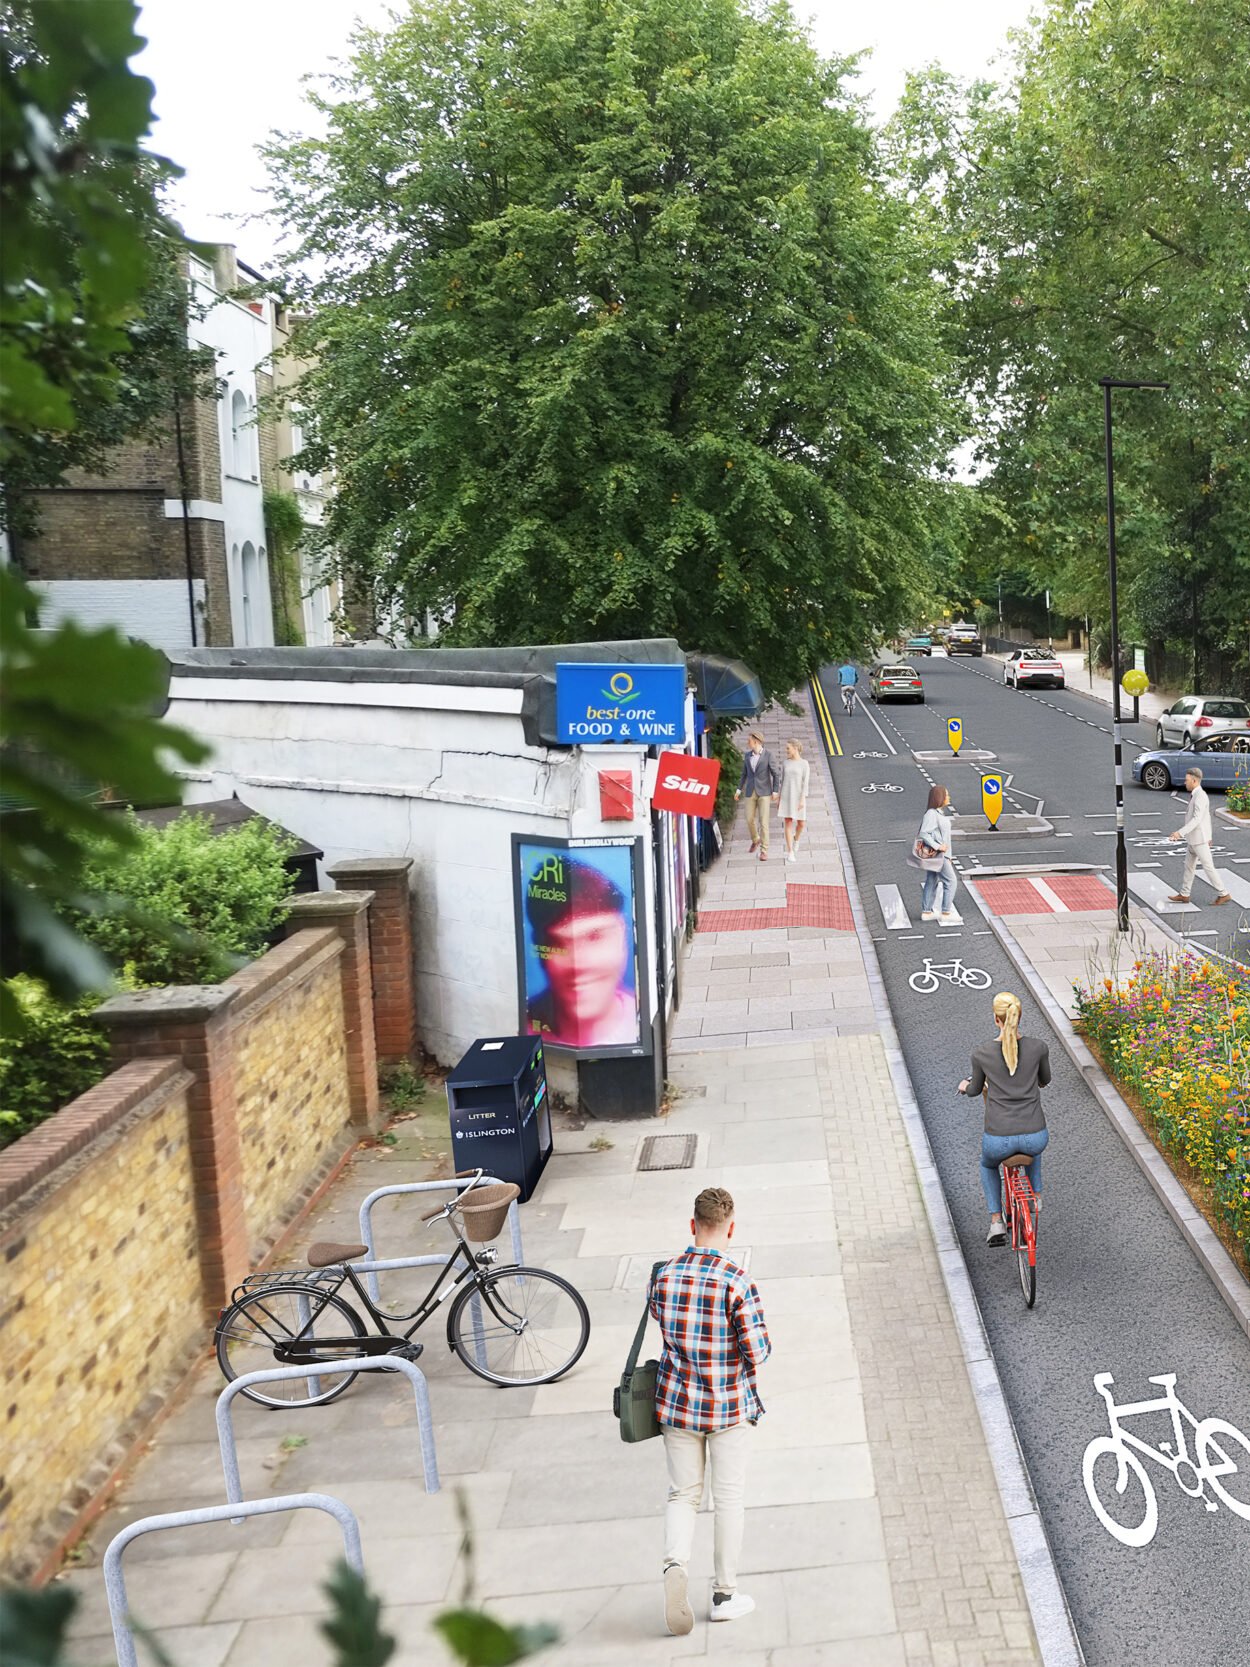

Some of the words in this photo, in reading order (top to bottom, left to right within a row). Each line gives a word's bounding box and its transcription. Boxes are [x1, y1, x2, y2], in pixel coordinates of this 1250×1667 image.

[586, 706, 656, 720] best-one
[568, 723, 613, 736] FOOD
[619, 723, 631, 736] &
[638, 723, 676, 736] WINE
[662, 775, 711, 796] Sun
[526, 851, 563, 884] CRi
[528, 884, 567, 902] Miracles
[468, 1112, 496, 1120] LITTER
[465, 1127, 515, 1138] ISLINGTON
